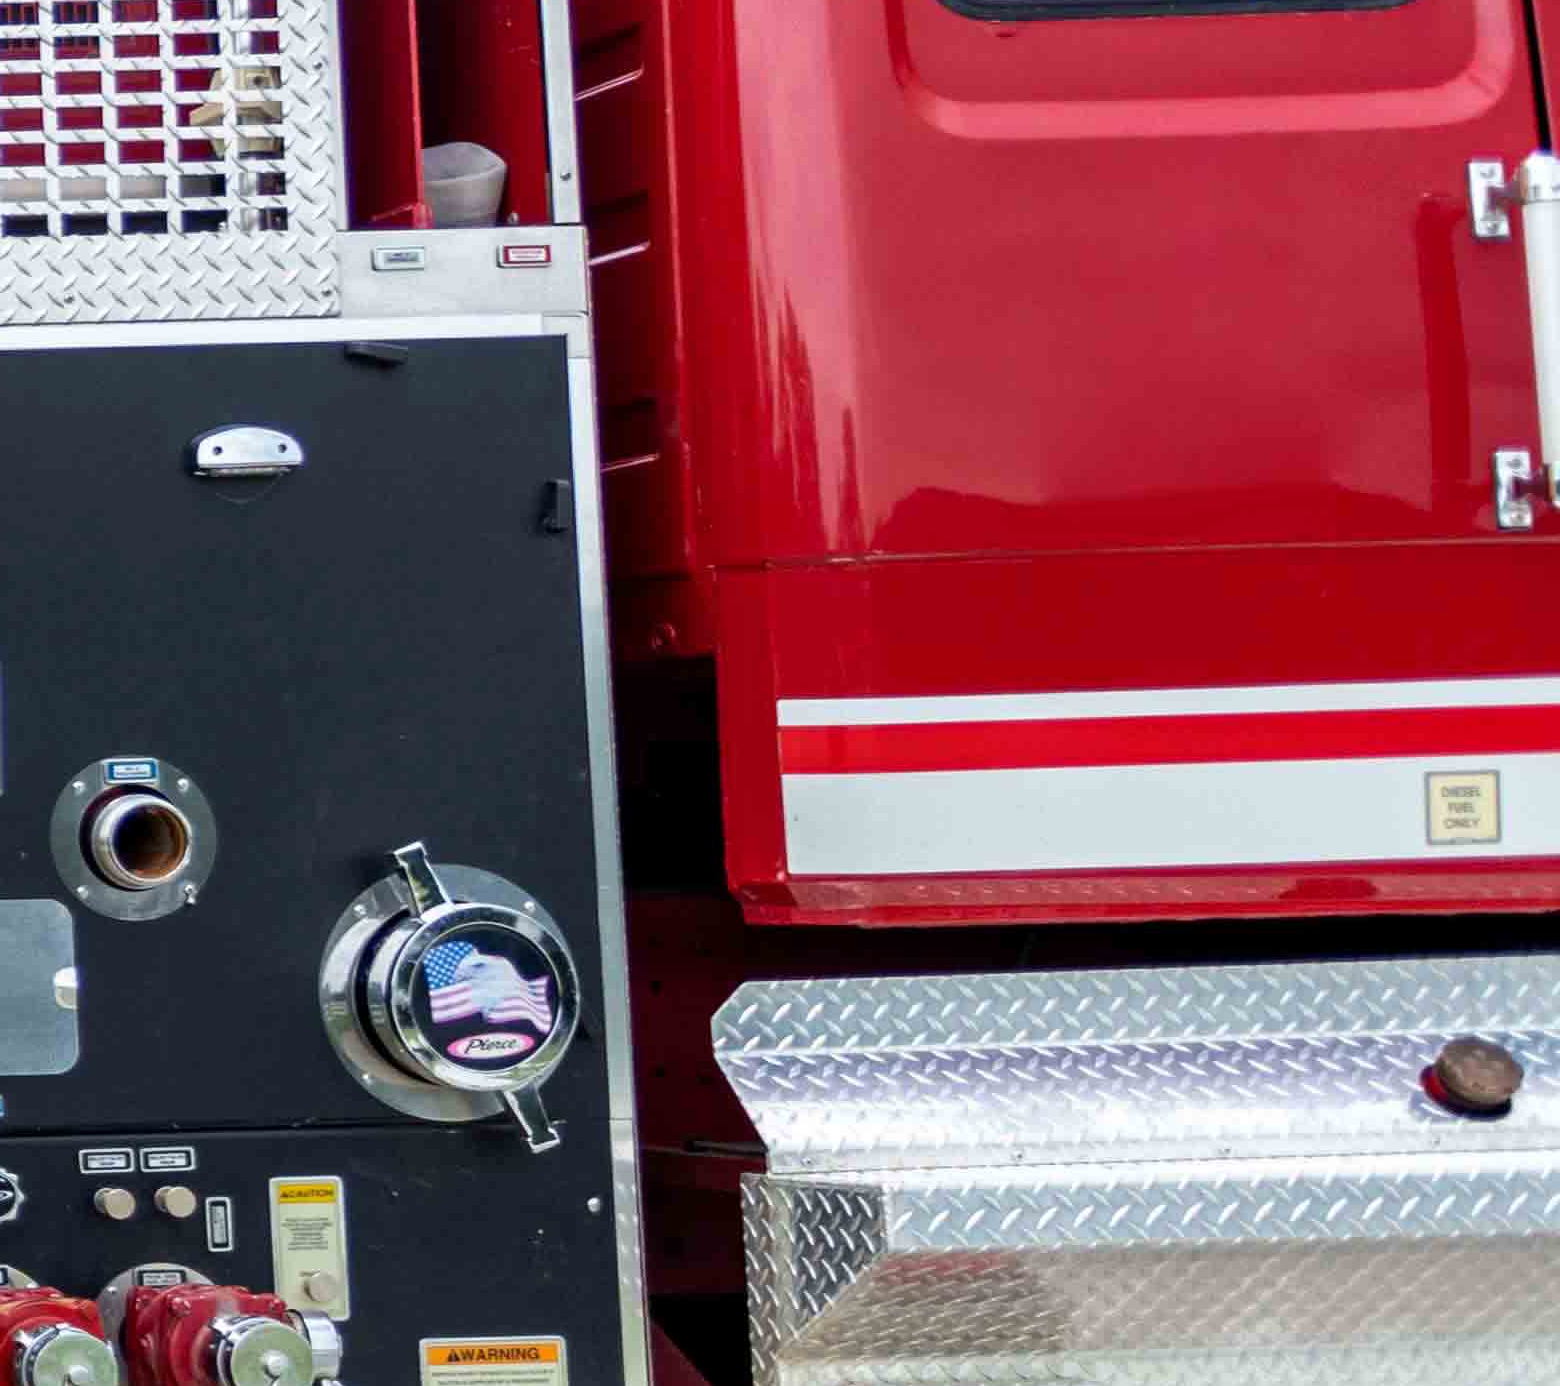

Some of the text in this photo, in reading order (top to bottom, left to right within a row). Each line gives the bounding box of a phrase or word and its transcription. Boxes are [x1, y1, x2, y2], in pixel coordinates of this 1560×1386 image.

[1447, 801, 1475, 814] FUEL
[1442, 817, 1481, 830] ONLY
[464, 1037, 517, 1055] Pierce
[289, 1187, 334, 1199] CAUTION
[461, 1347, 540, 1362] WARNING
